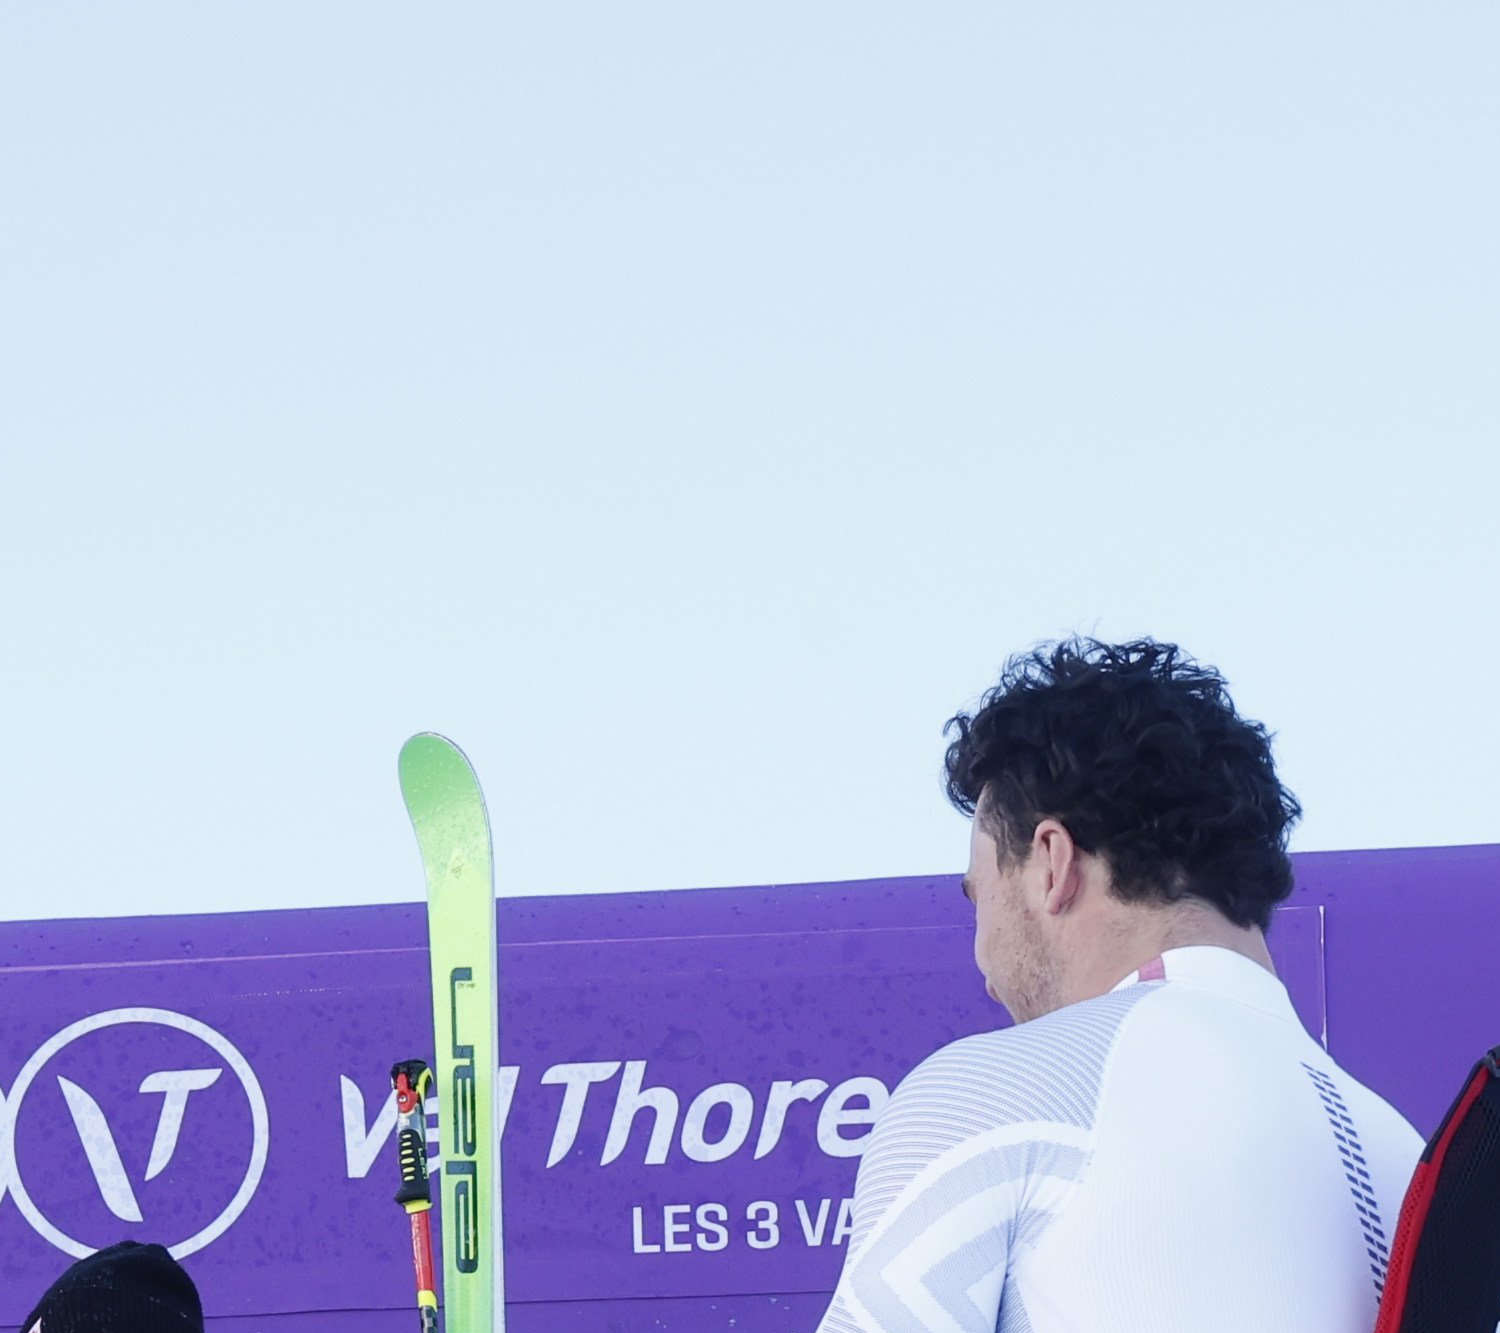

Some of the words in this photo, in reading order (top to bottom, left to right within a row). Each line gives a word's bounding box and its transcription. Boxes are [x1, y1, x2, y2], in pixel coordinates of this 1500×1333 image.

[537, 1060, 893, 1169] Thore
[632, 1202, 729, 1254] LES
[746, 1199, 779, 1250] 3
